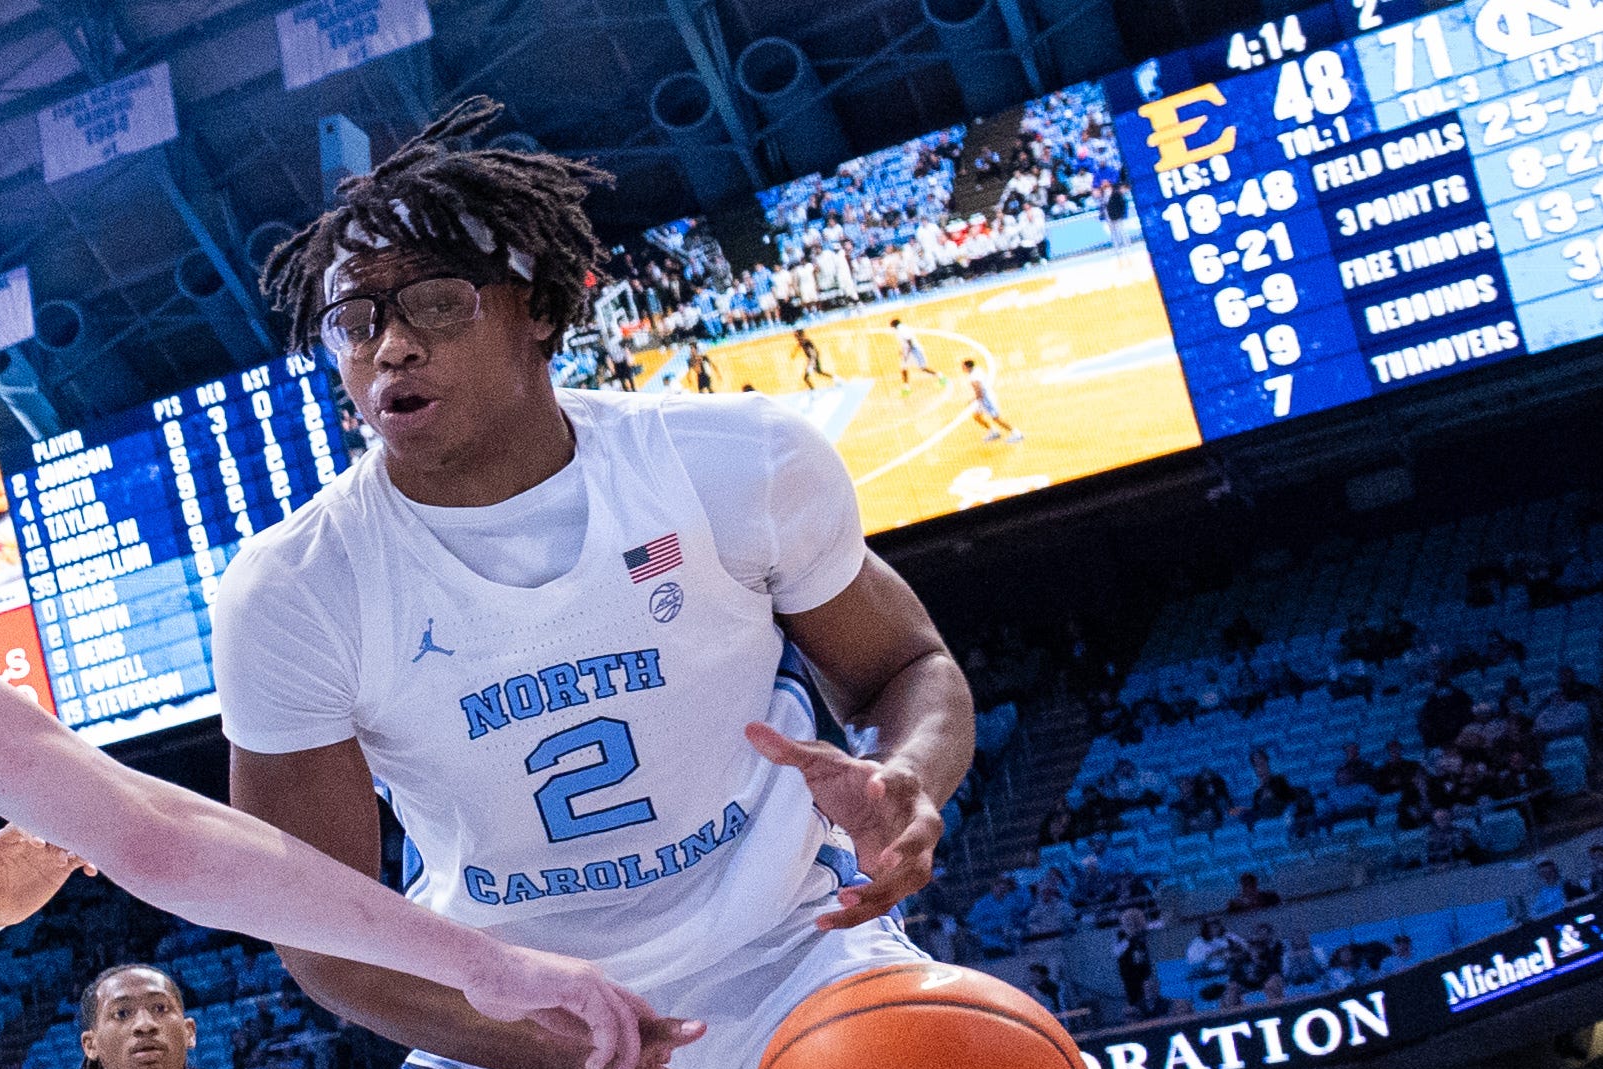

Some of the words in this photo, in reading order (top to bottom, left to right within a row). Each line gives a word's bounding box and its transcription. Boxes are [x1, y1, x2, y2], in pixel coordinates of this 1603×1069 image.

[1227, 15, 1307, 71] 4:14
[1378, 14, 1453, 92] 71
[1138, 82, 1236, 173] E
[1272, 50, 1352, 125] 48
[1312, 148, 1383, 192] FIELD
[1382, 122, 1465, 170] GOALS
[1161, 169, 1299, 243] 18-48
[1335, 206, 1358, 238] 3
[1356, 183, 1434, 232] POINT
[1434, 174, 1471, 210] FG
[1189, 222, 1294, 286] 6-21
[1338, 255, 1397, 290] FREE
[1393, 221, 1495, 274] THROWS
[1213, 272, 1299, 328] 6-9
[1364, 274, 1498, 336] REBOUNDS
[1240, 324, 1301, 373] 19
[1369, 321, 1520, 384] TURNOVERS
[32, 430, 84, 463] PLAYER
[153, 396, 182, 421] PTS
[241, 365, 270, 391] AST
[1264, 374, 1294, 418] 7
[35, 445, 113, 491] JOHNSON
[206, 406, 227, 434] 3
[251, 391, 273, 419] 0
[299, 377, 314, 403] 1
[18, 498, 35, 522] 4
[38, 478, 96, 516] SMITH
[169, 446, 190, 474] 5
[216, 433, 232, 459] 1
[261, 418, 275, 445] 1
[22, 523, 42, 548] 11
[44, 502, 109, 541] TAYLOR
[219, 457, 240, 486] 5
[263, 444, 285, 472] 2
[26, 548, 47, 574] 15
[270, 470, 291, 499] 2
[315, 455, 337, 485] 2
[42, 597, 58, 622] 0
[62, 580, 118, 615] EVANS
[68, 604, 132, 641] BROWN
[57, 673, 77, 699] 11
[80, 655, 148, 694] POWELL
[86, 671, 185, 720] STEVENSON
[460, 648, 665, 740] NORTH
[524, 716, 657, 844] 2
[464, 801, 748, 905] CAROLINA
[1441, 936, 1555, 1006] Michael
